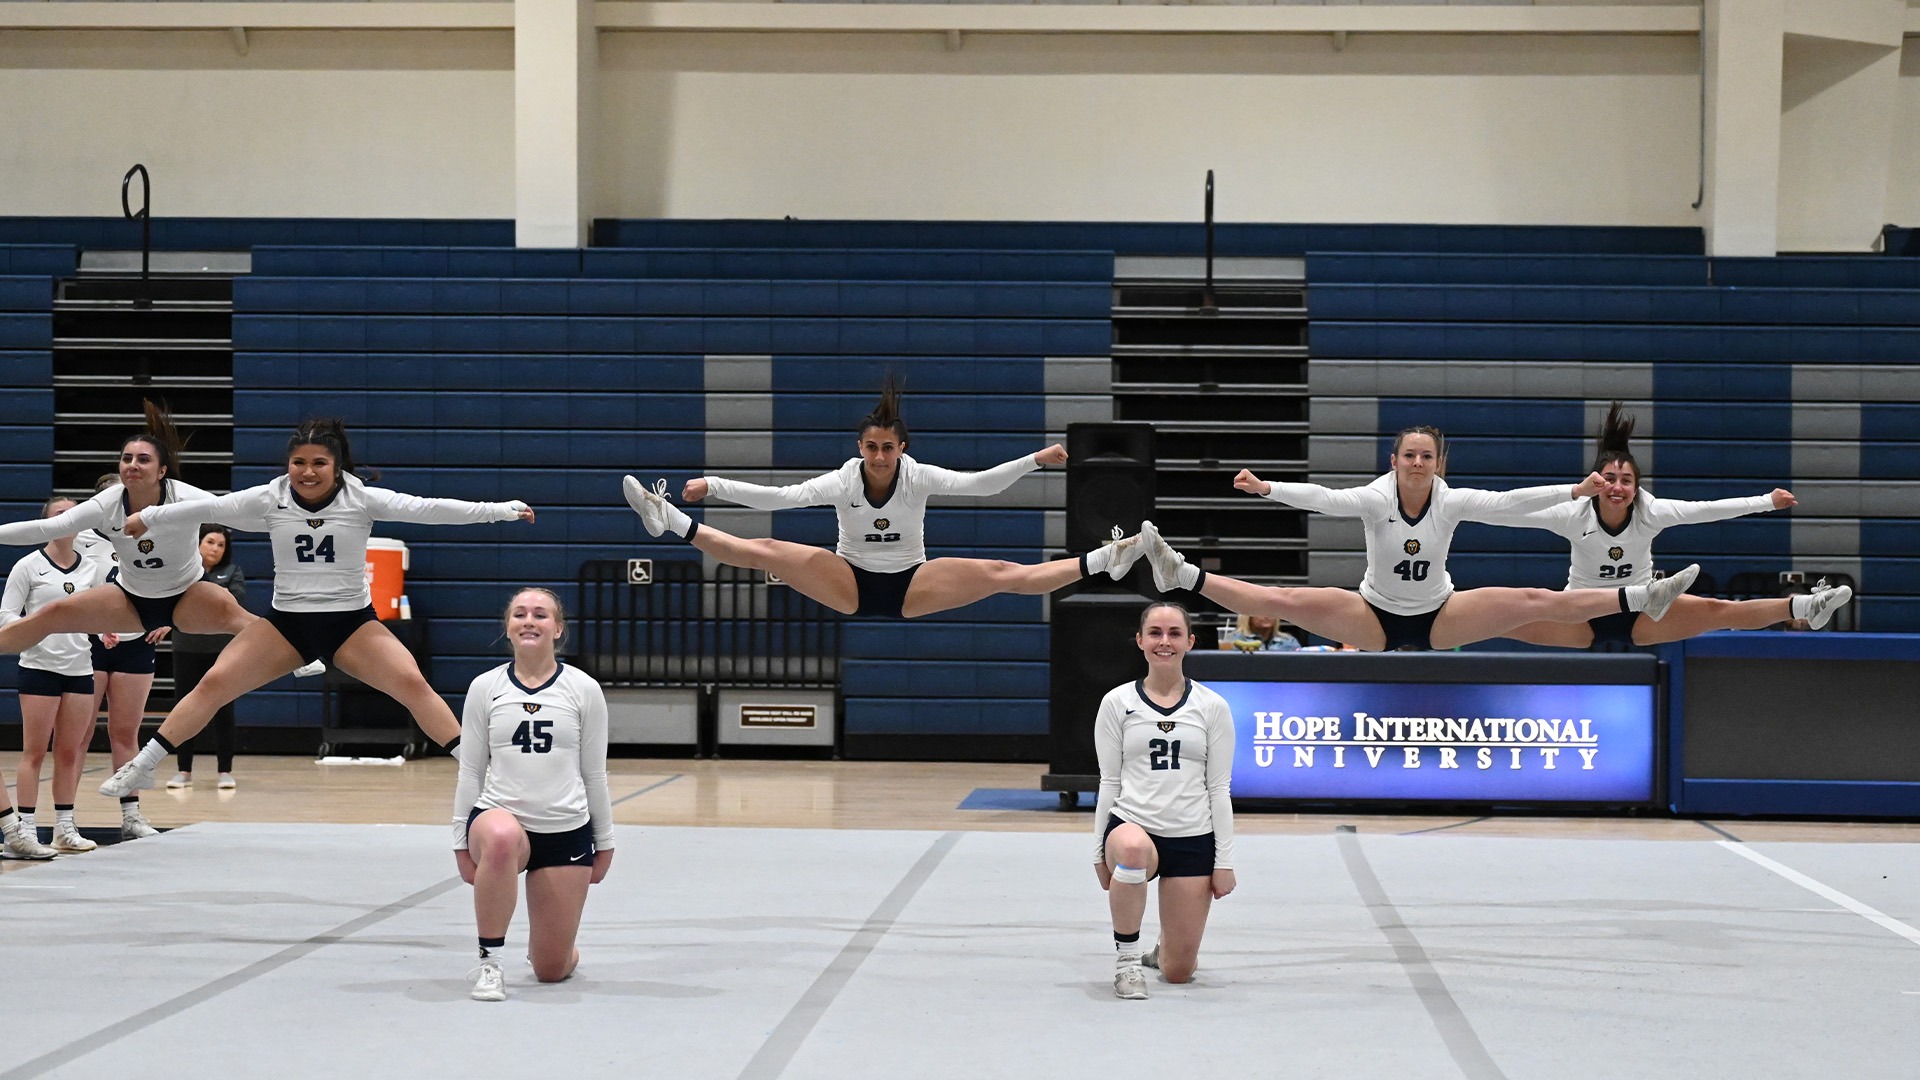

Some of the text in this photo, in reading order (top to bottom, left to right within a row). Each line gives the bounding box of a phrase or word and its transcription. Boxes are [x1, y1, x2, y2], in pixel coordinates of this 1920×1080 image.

[295, 534, 335, 563] 24
[1393, 559, 1431, 582] 40
[1599, 563, 1633, 579] 26
[511, 720, 554, 754] 45
[1253, 711, 1599, 743] HOPE INTERNATIONAL
[1148, 738, 1181, 771] 21
[1253, 745, 1599, 770] UNIVERSITY
